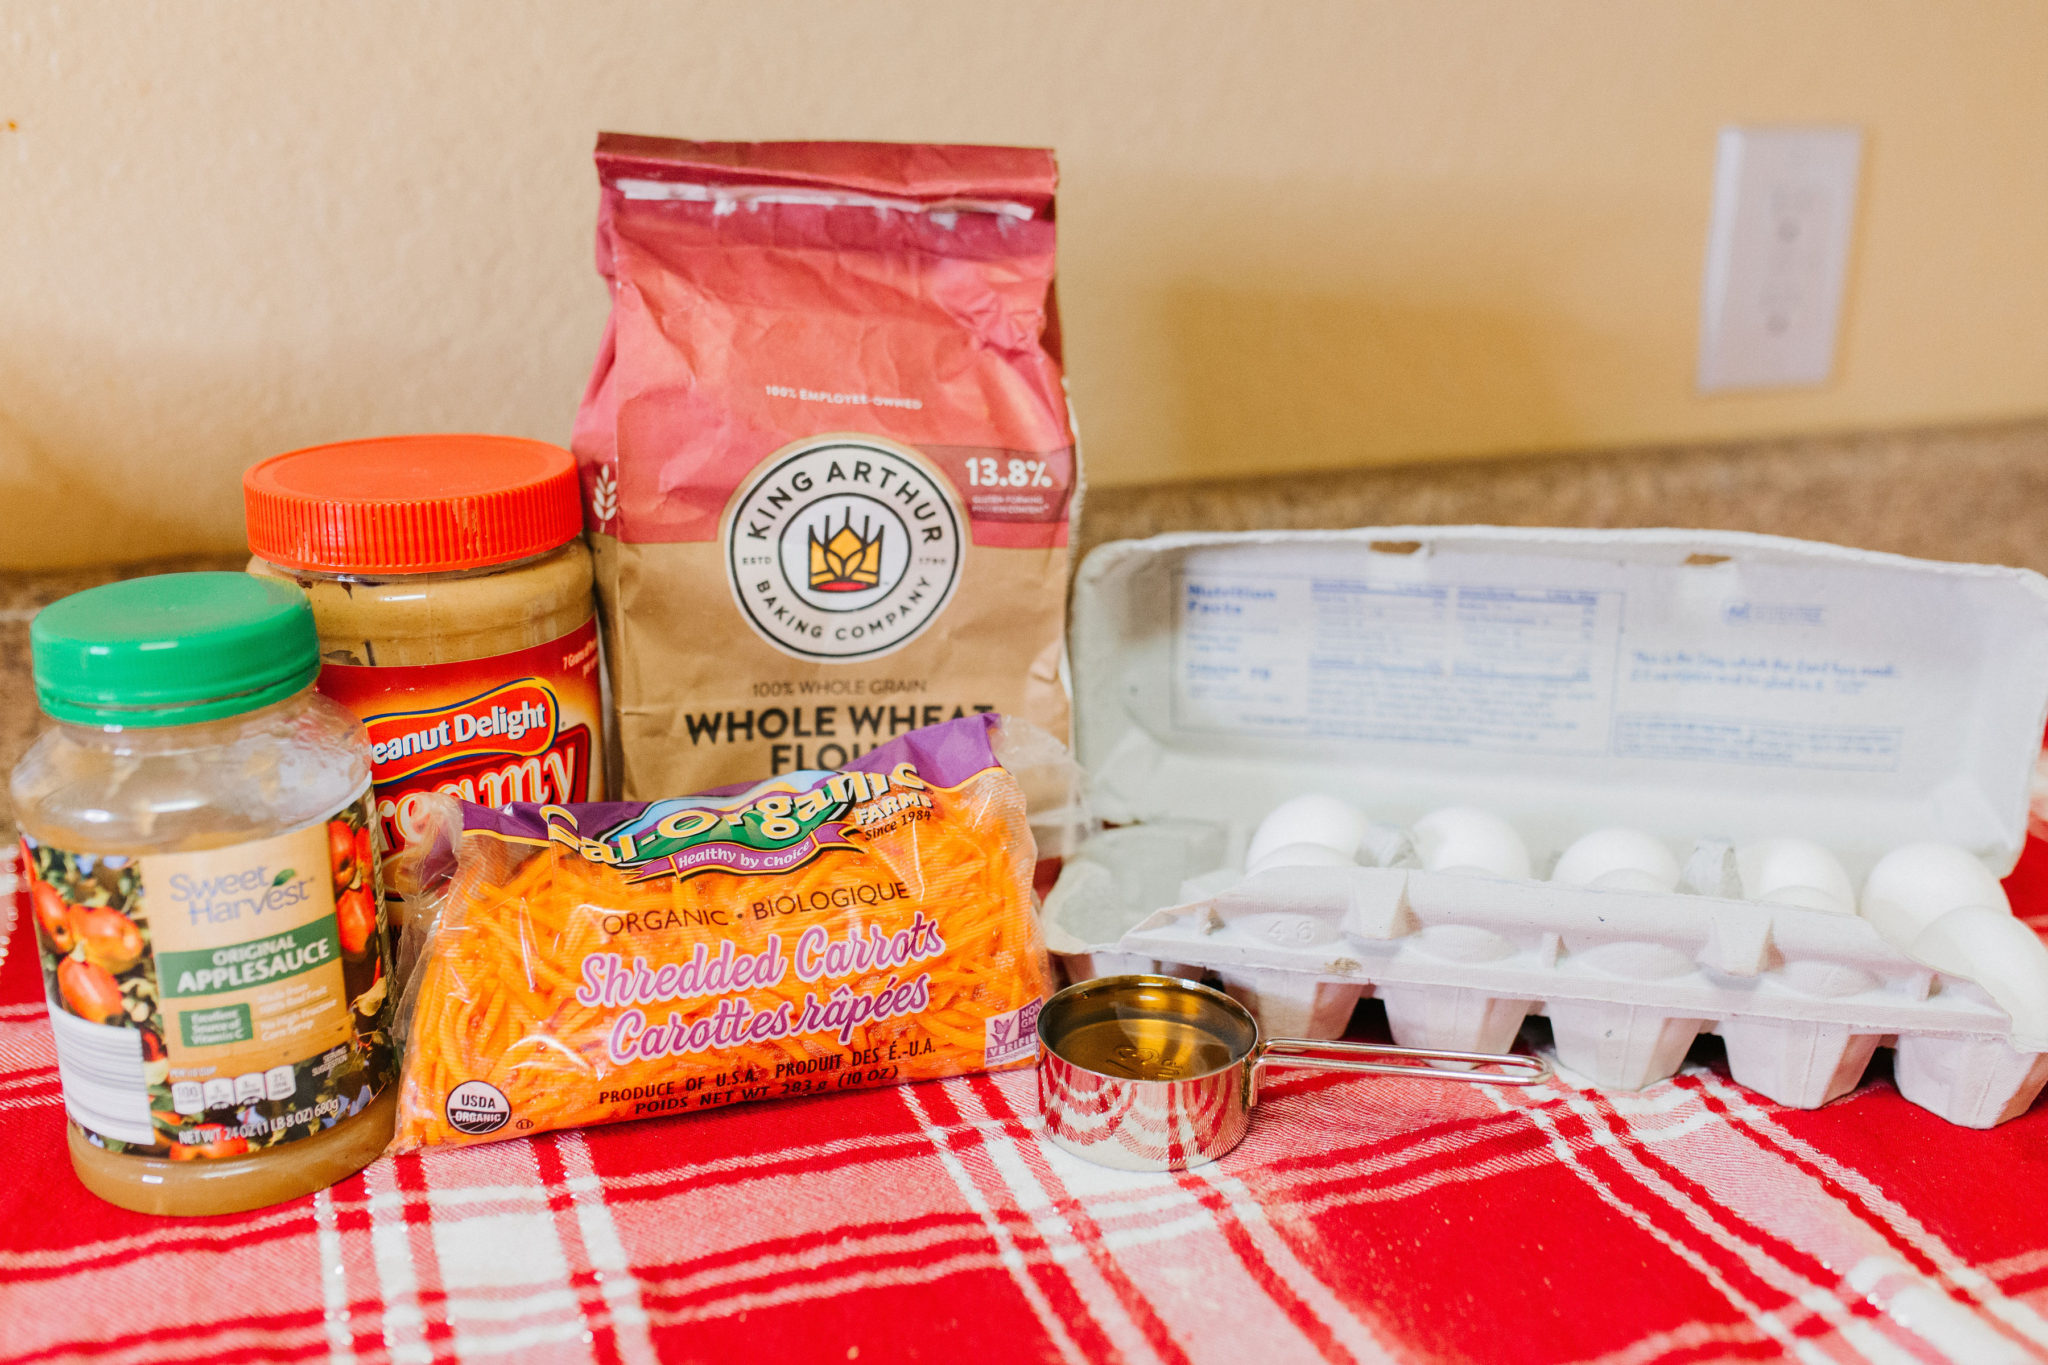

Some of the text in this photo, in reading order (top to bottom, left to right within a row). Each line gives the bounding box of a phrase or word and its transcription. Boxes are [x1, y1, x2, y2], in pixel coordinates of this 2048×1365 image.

[765, 385, 797, 399] 100%
[965, 457, 1053, 488] 13.8%
[747, 461, 943, 544] KING ARTHUR
[742, 556, 772, 565] ESTD
[756, 577, 931, 641] BAKING COMPANY
[753, 678, 927, 697] 100% WHOLE GRAIN
[371, 700, 548, 764] eanut Delight
[684, 705, 838, 746] WHOLE
[771, 743, 879, 775] FLO
[377, 745, 576, 851] reamy
[539, 762, 925, 864] Cal-Organic
[864, 810, 932, 841] Since 1984
[678, 841, 811, 870] Healthy by Choice
[169, 866, 270, 901] Sweet
[188, 881, 310, 926] Harvest
[602, 881, 910, 936] ORGANIC BIOLOGIQUE
[177, 938, 331, 993] APPLESAUCE
[212, 934, 297, 966] ORIGINAL
[576, 910, 945, 1008] Shredded Carrots
[608, 973, 932, 1065] Carottes râpées
[1020, 1015, 1036, 1028] GM
[1021, 1002, 1042, 1019] NON
[989, 1032, 1037, 1057] VERIFIE
[311, 1054, 348, 1077] SUGGESTION
[600, 1037, 937, 1104] PRODUCE OF U.S.A. PRODUIT DES É.-U.A.
[461, 1094, 496, 1109] USDA
[635, 1065, 899, 1115] POIDS NET WT 283 g (10 OZ)
[178, 1098, 339, 1144] NET WT 24 OZ (1 LB 8 OZ) 680g
[455, 1111, 502, 1123] ORGANIC
